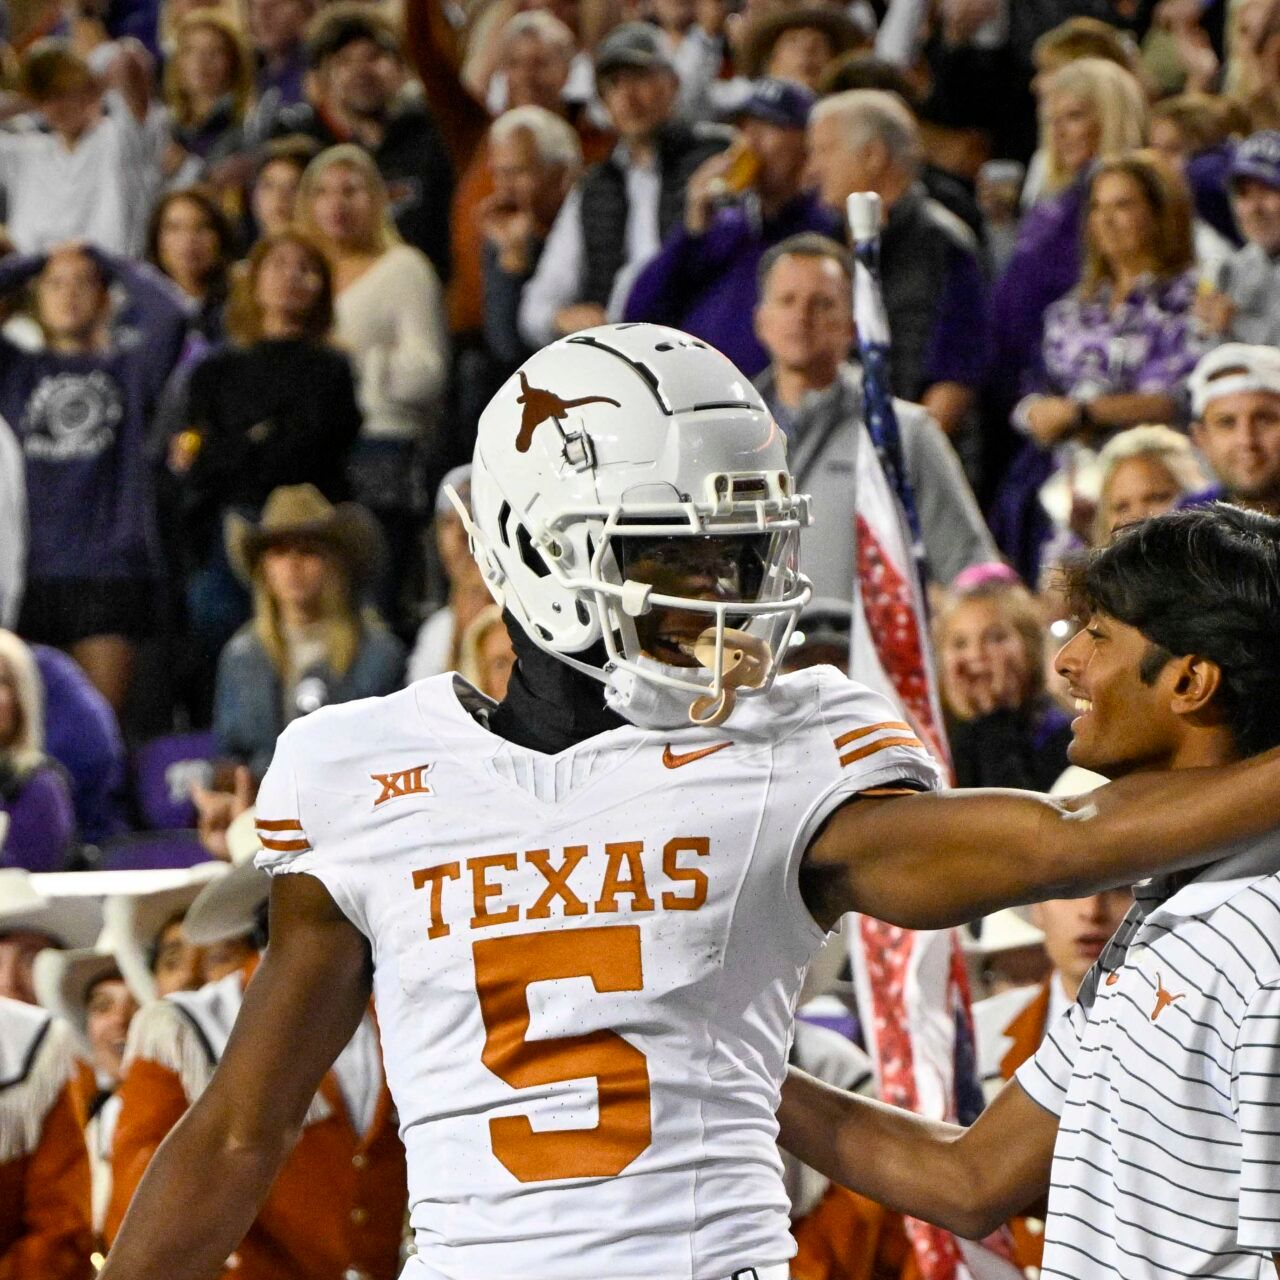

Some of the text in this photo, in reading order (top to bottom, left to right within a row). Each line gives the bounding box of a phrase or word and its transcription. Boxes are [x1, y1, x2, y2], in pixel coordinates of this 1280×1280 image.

[370, 764, 431, 806] XII
[412, 836, 711, 940] TEXAS
[472, 924, 652, 1183] 5
